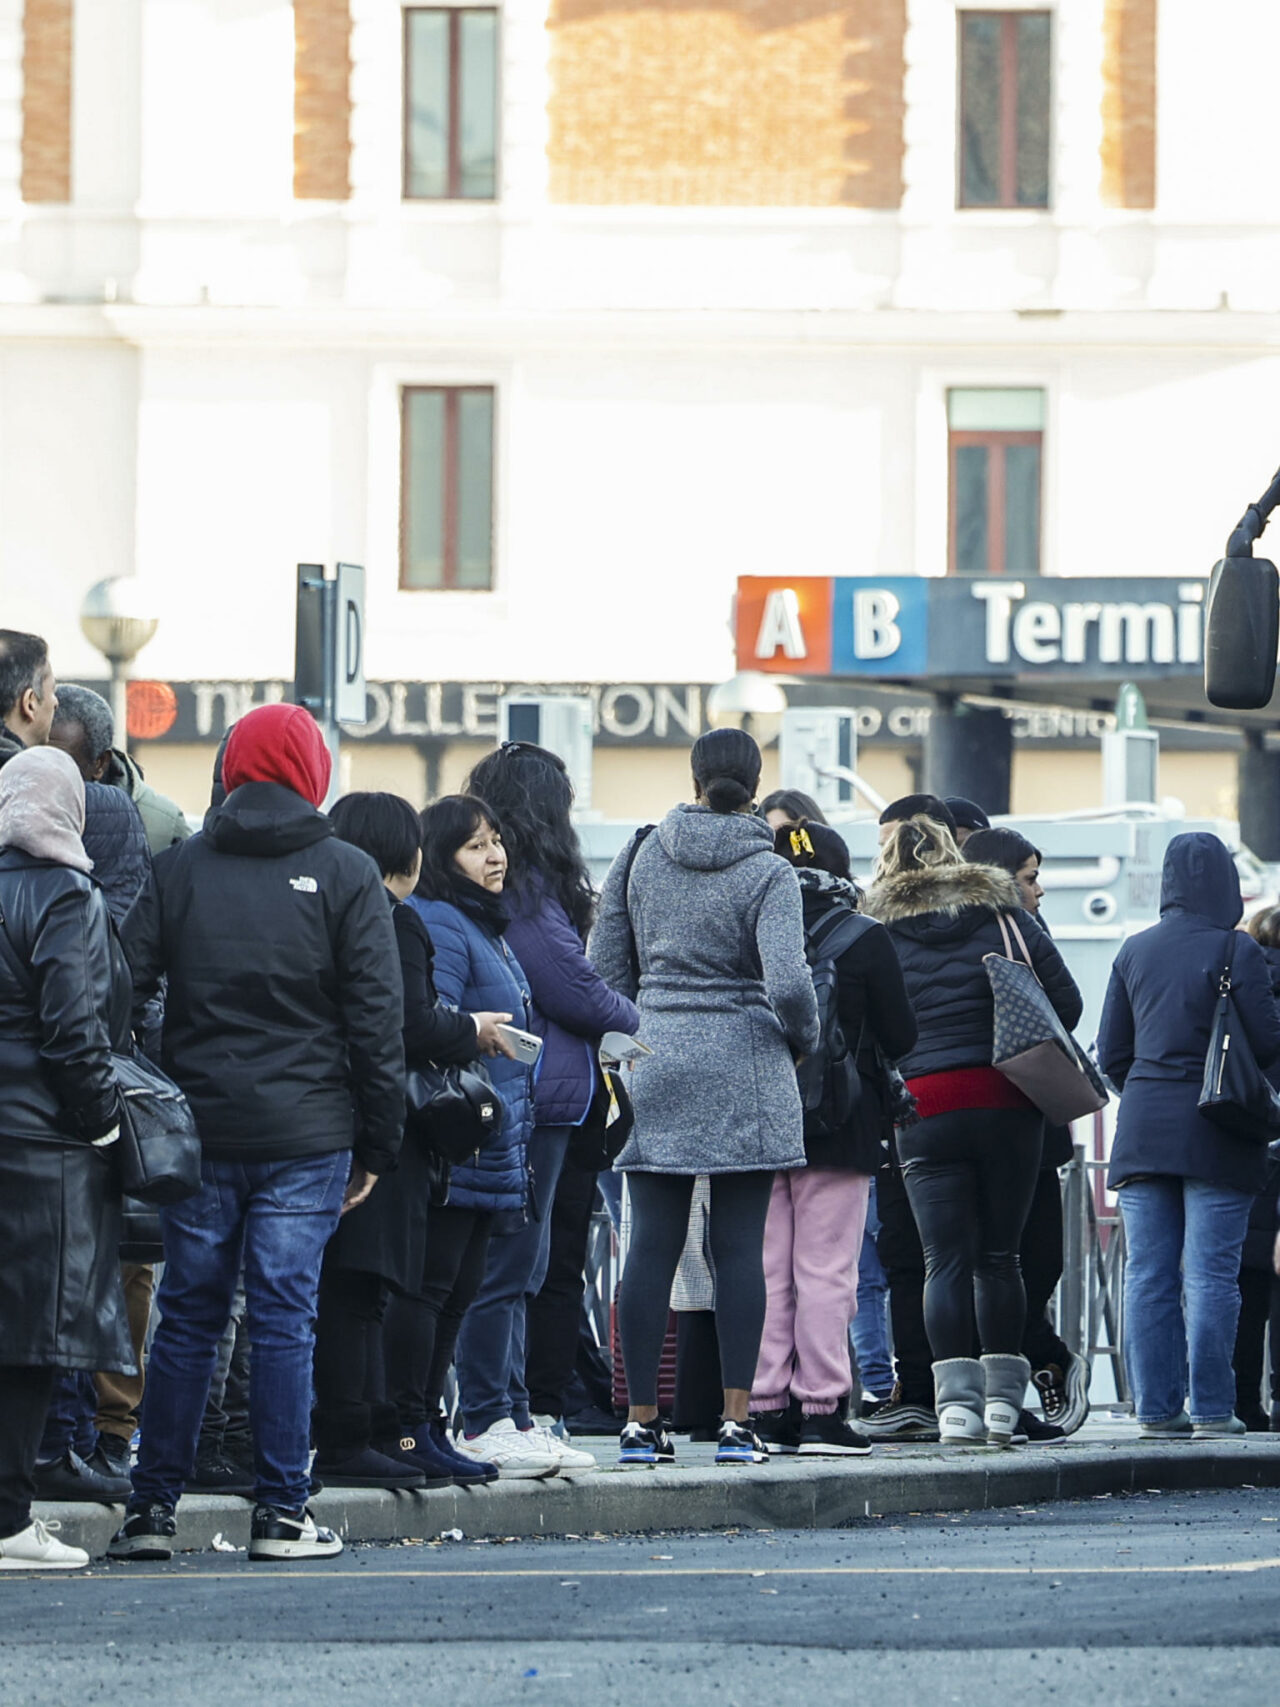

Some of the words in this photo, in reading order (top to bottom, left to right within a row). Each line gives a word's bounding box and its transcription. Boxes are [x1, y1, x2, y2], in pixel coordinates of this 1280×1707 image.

[346, 600, 361, 683] D
[755, 588, 807, 660] A
[853, 588, 901, 660] B
[971, 581, 1202, 664] Termi
